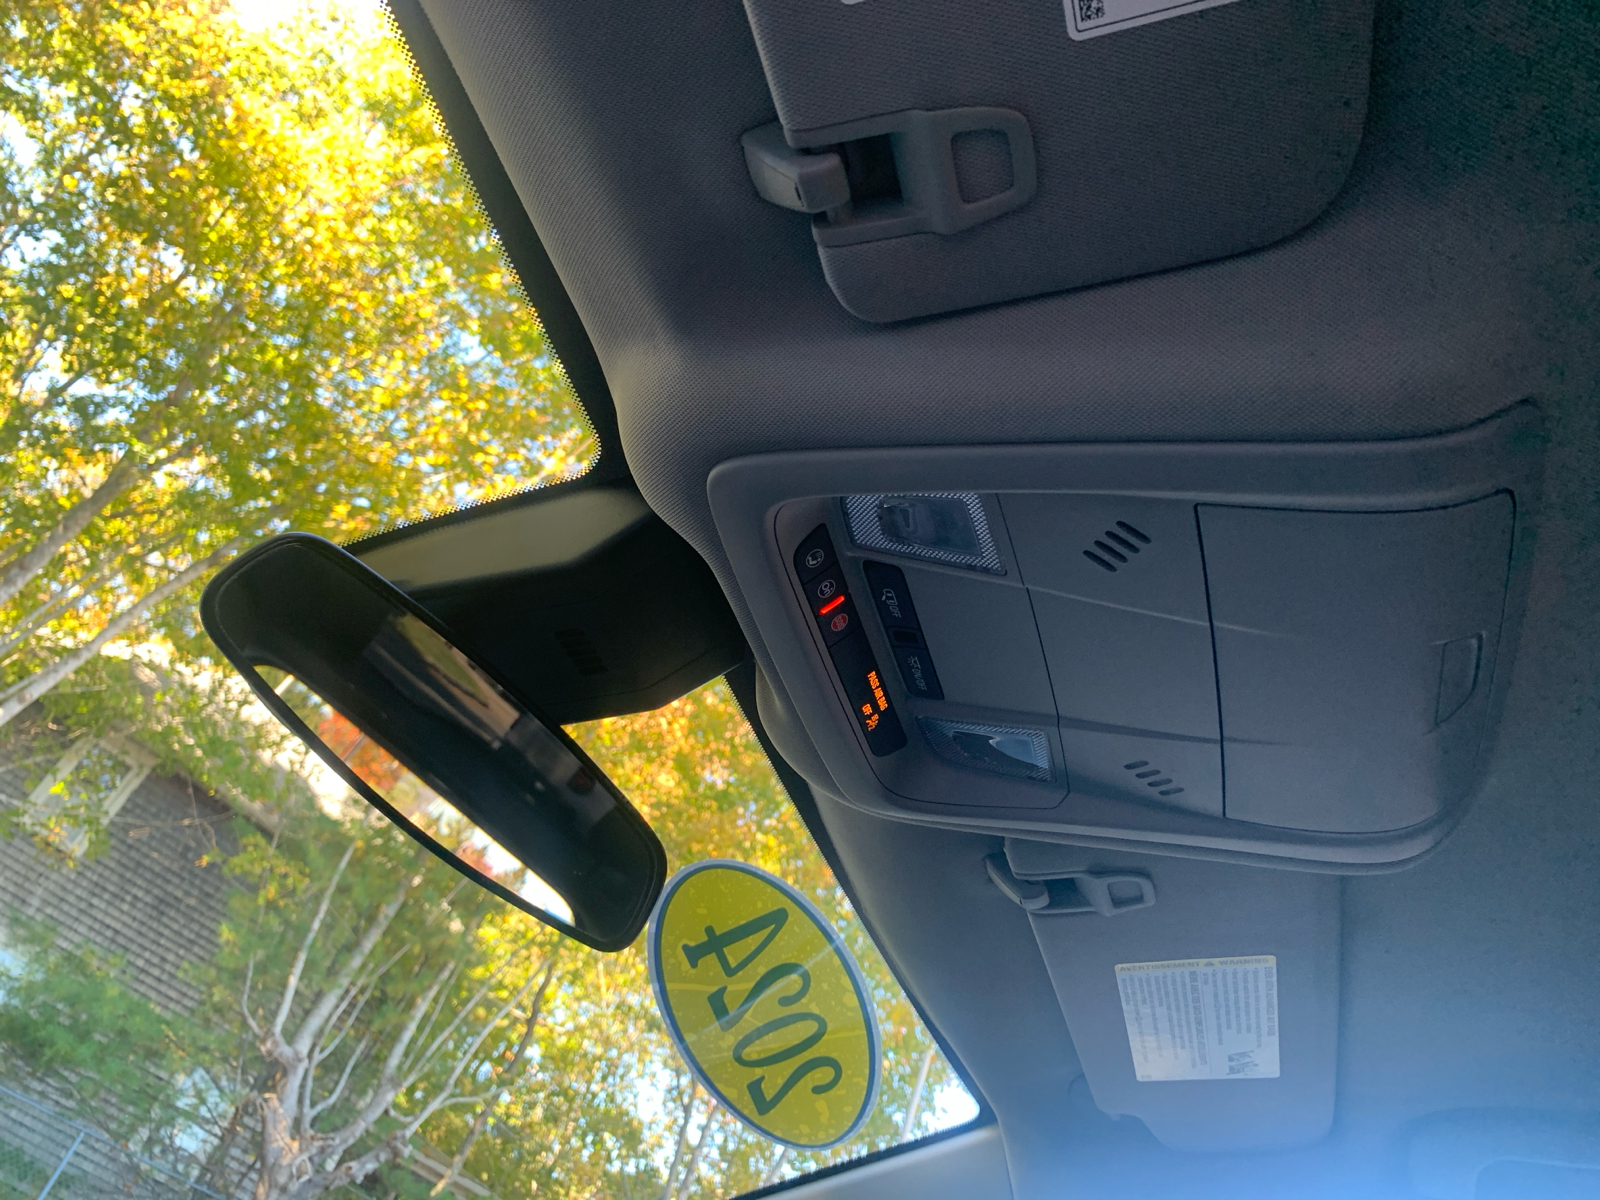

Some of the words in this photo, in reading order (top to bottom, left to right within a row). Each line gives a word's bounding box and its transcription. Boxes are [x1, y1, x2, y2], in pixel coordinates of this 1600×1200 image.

[889, 605, 902, 618] OFF
[834, 615, 845, 630] SOS
[912, 668, 928, 691] ON/OFF
[867, 671, 880, 690] PASS
[878, 696, 888, 711] BAG
[862, 703, 873, 716] OFF
[1119, 961, 1200, 972] AVERTISSEMENT
[1218, 957, 1270, 966] WARNING
